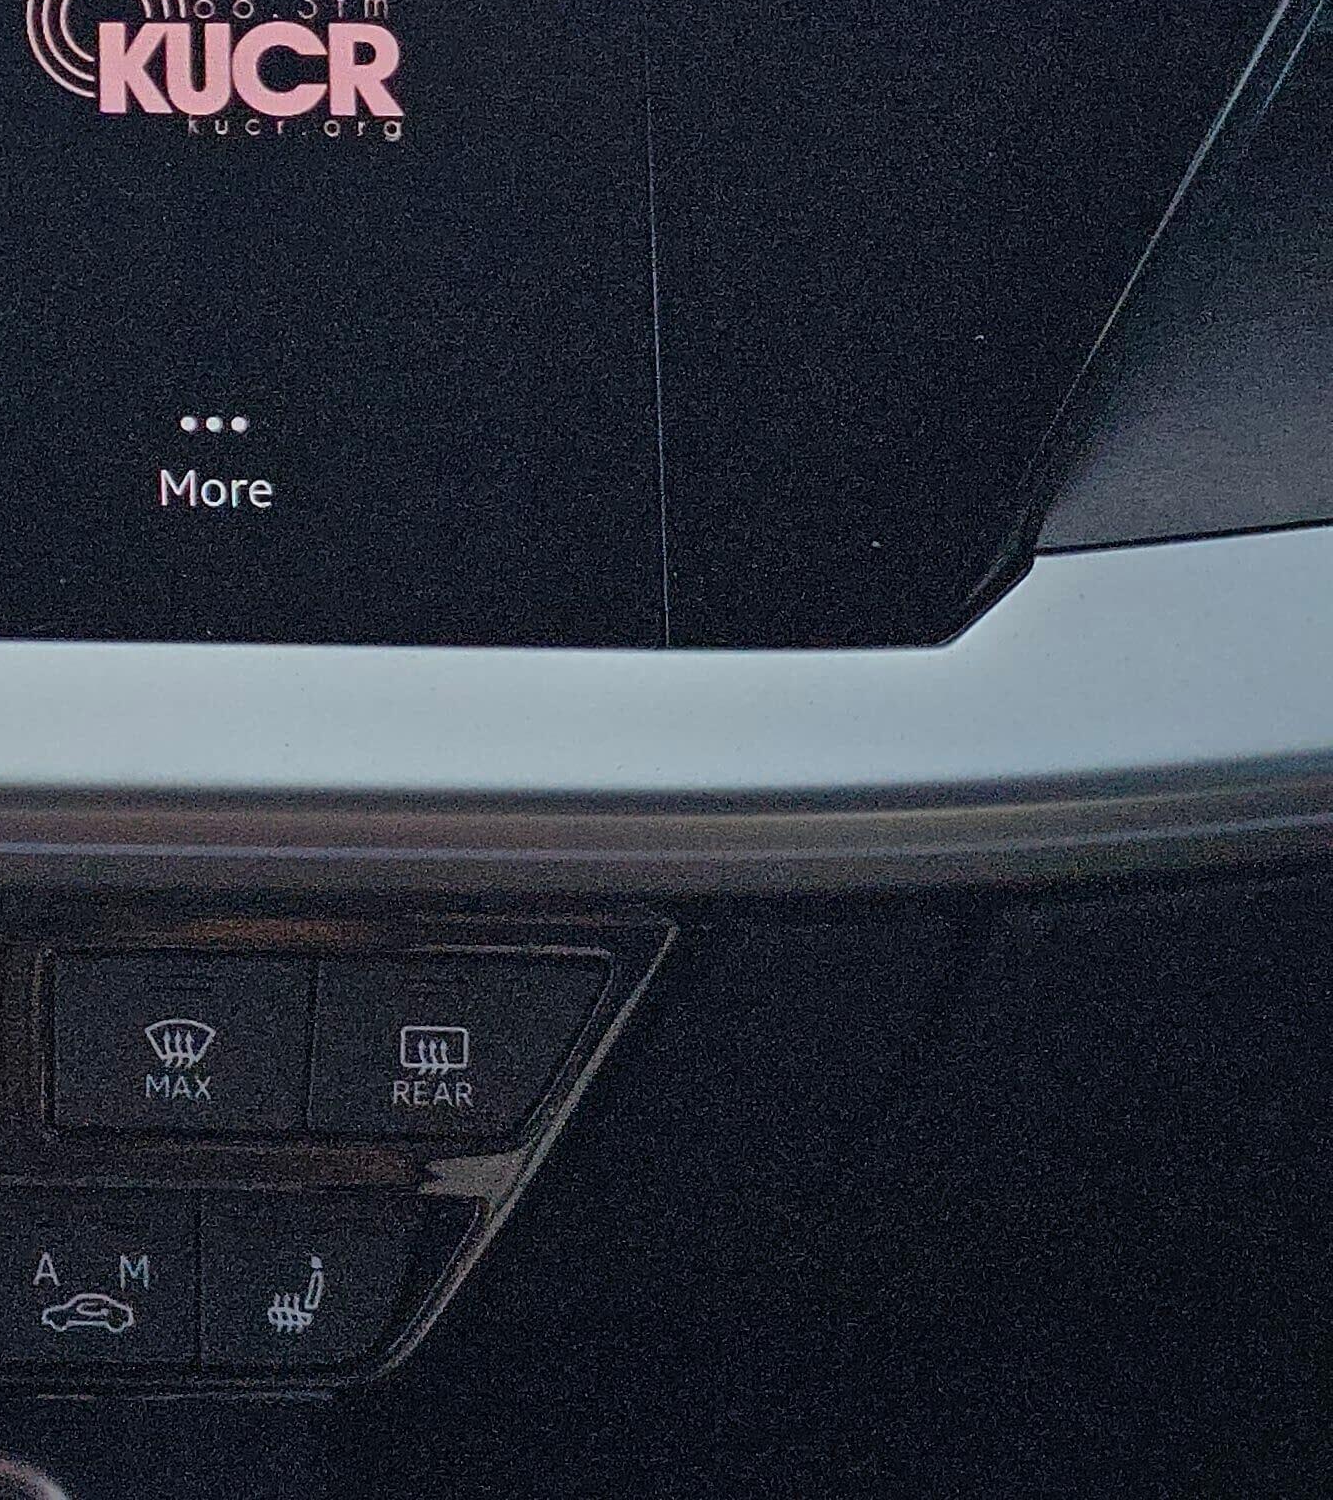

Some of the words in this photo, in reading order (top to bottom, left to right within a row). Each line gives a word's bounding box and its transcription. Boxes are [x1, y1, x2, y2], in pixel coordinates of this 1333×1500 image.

[98, 20, 404, 117] KUCR
[159, 468, 273, 509] More
[143, 1073, 212, 1102] MAX
[391, 1080, 474, 1108] REAR
[33, 1254, 59, 1286] A
[118, 1255, 151, 1288] M
